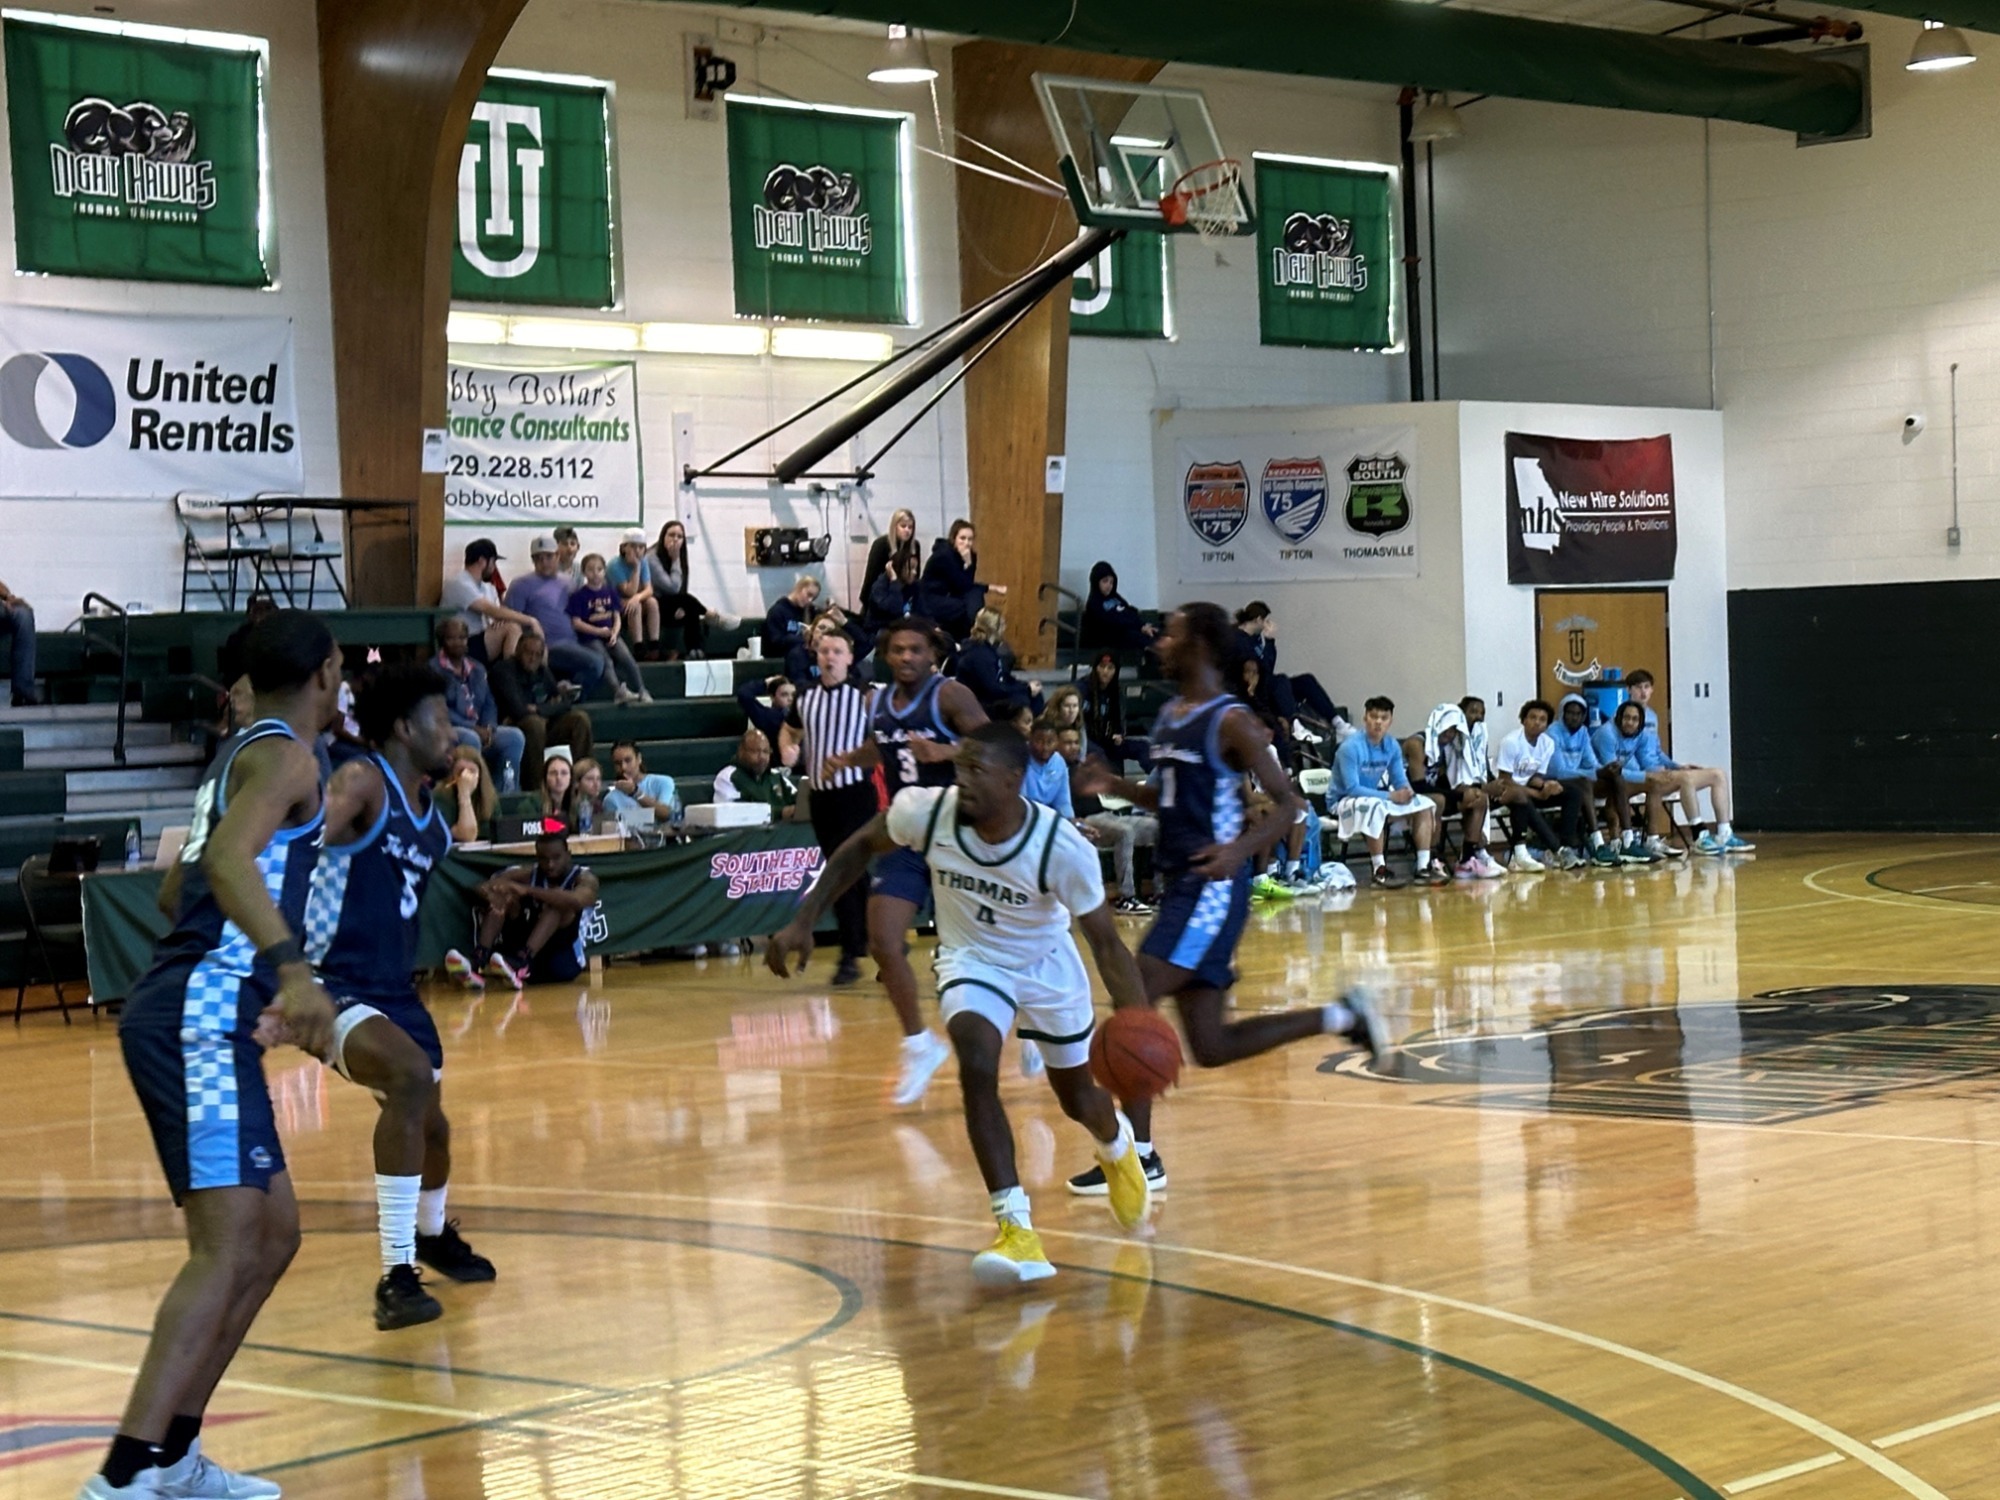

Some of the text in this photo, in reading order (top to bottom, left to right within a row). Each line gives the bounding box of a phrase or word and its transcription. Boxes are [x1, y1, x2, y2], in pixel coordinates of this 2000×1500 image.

[126, 358, 278, 405] United
[450, 369, 616, 416] bby Dollar's
[129, 408, 294, 453] Rentals
[447, 410, 630, 442] iance Consultants
[446, 454, 594, 479] 29.228.5112
[1267, 467, 1321, 477] HONDA
[1353, 469, 1400, 480] SOUTH
[1358, 461, 1395, 471] DEEP
[446, 490, 599, 511] obbydollar.com
[1269, 492, 1293, 512] 75
[1559, 490, 1669, 508] New Hire Solutions
[1565, 520, 1599, 535] Providing
[1601, 520, 1626, 534] People
[1635, 519, 1669, 531] Positions
[1202, 551, 1234, 561] TIFTON
[1280, 549, 1313, 560] TIFTON
[1343, 545, 1414, 558] THOMASVILLE
[897, 748, 918, 783] 3
[710, 846, 821, 878] SOUTHERN
[727, 870, 805, 898] STATES
[936, 869, 1029, 906] THOMAS
[976, 905, 996, 925] 4
